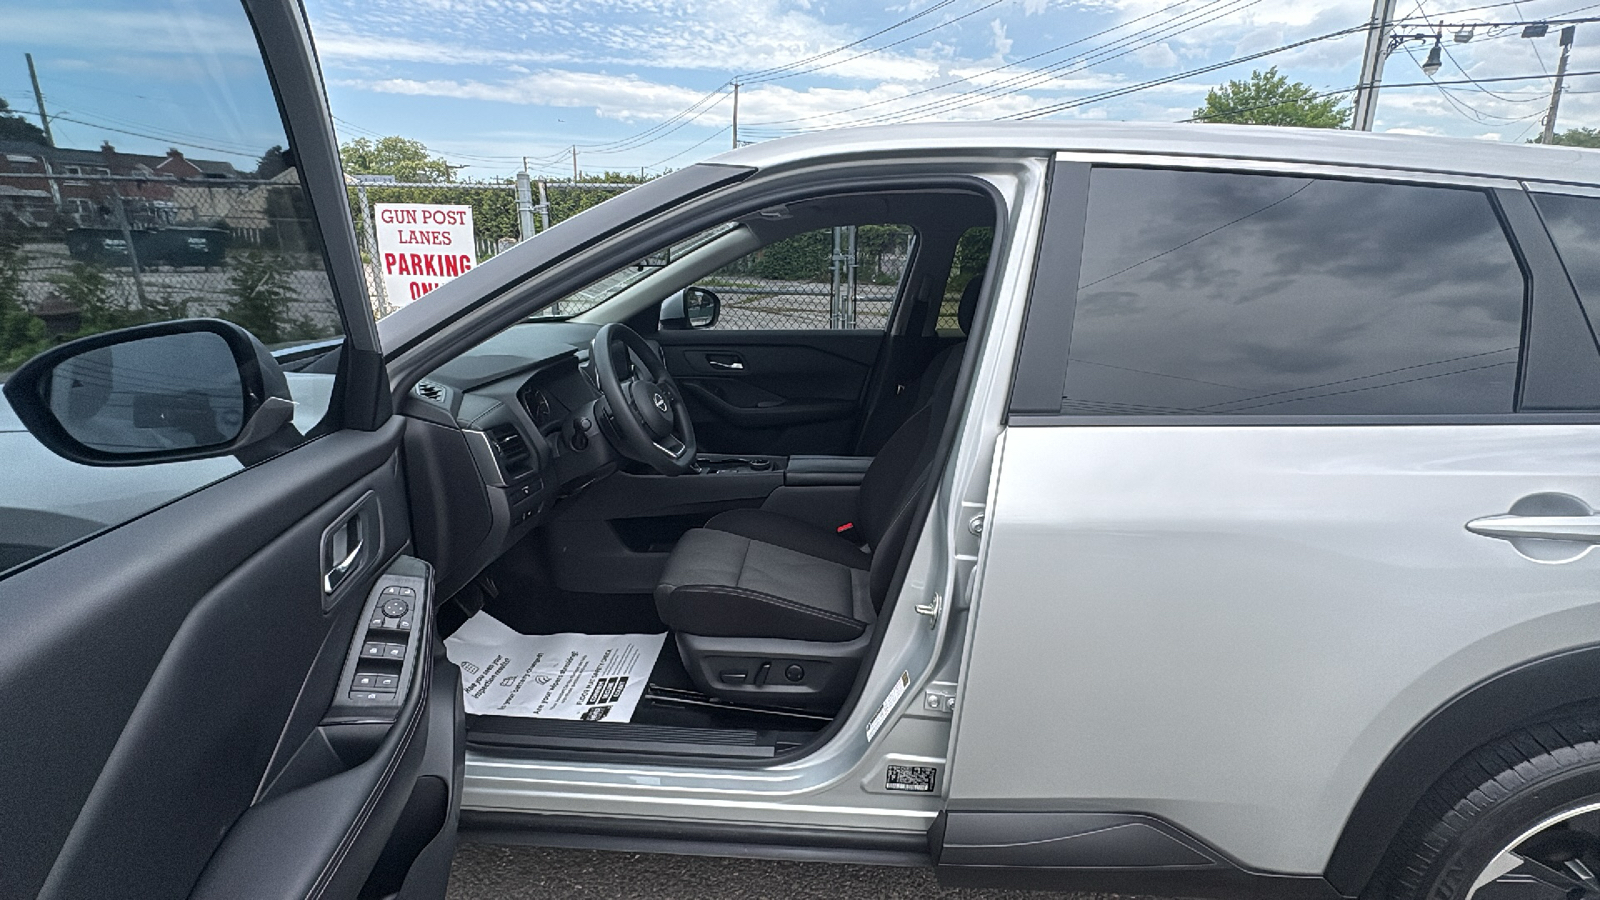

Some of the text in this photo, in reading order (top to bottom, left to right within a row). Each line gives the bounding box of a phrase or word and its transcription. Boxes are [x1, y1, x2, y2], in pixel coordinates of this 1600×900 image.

[381, 209, 466, 225] GUN POST
[397, 230, 452, 245] LANES
[385, 252, 471, 277] PARKING
